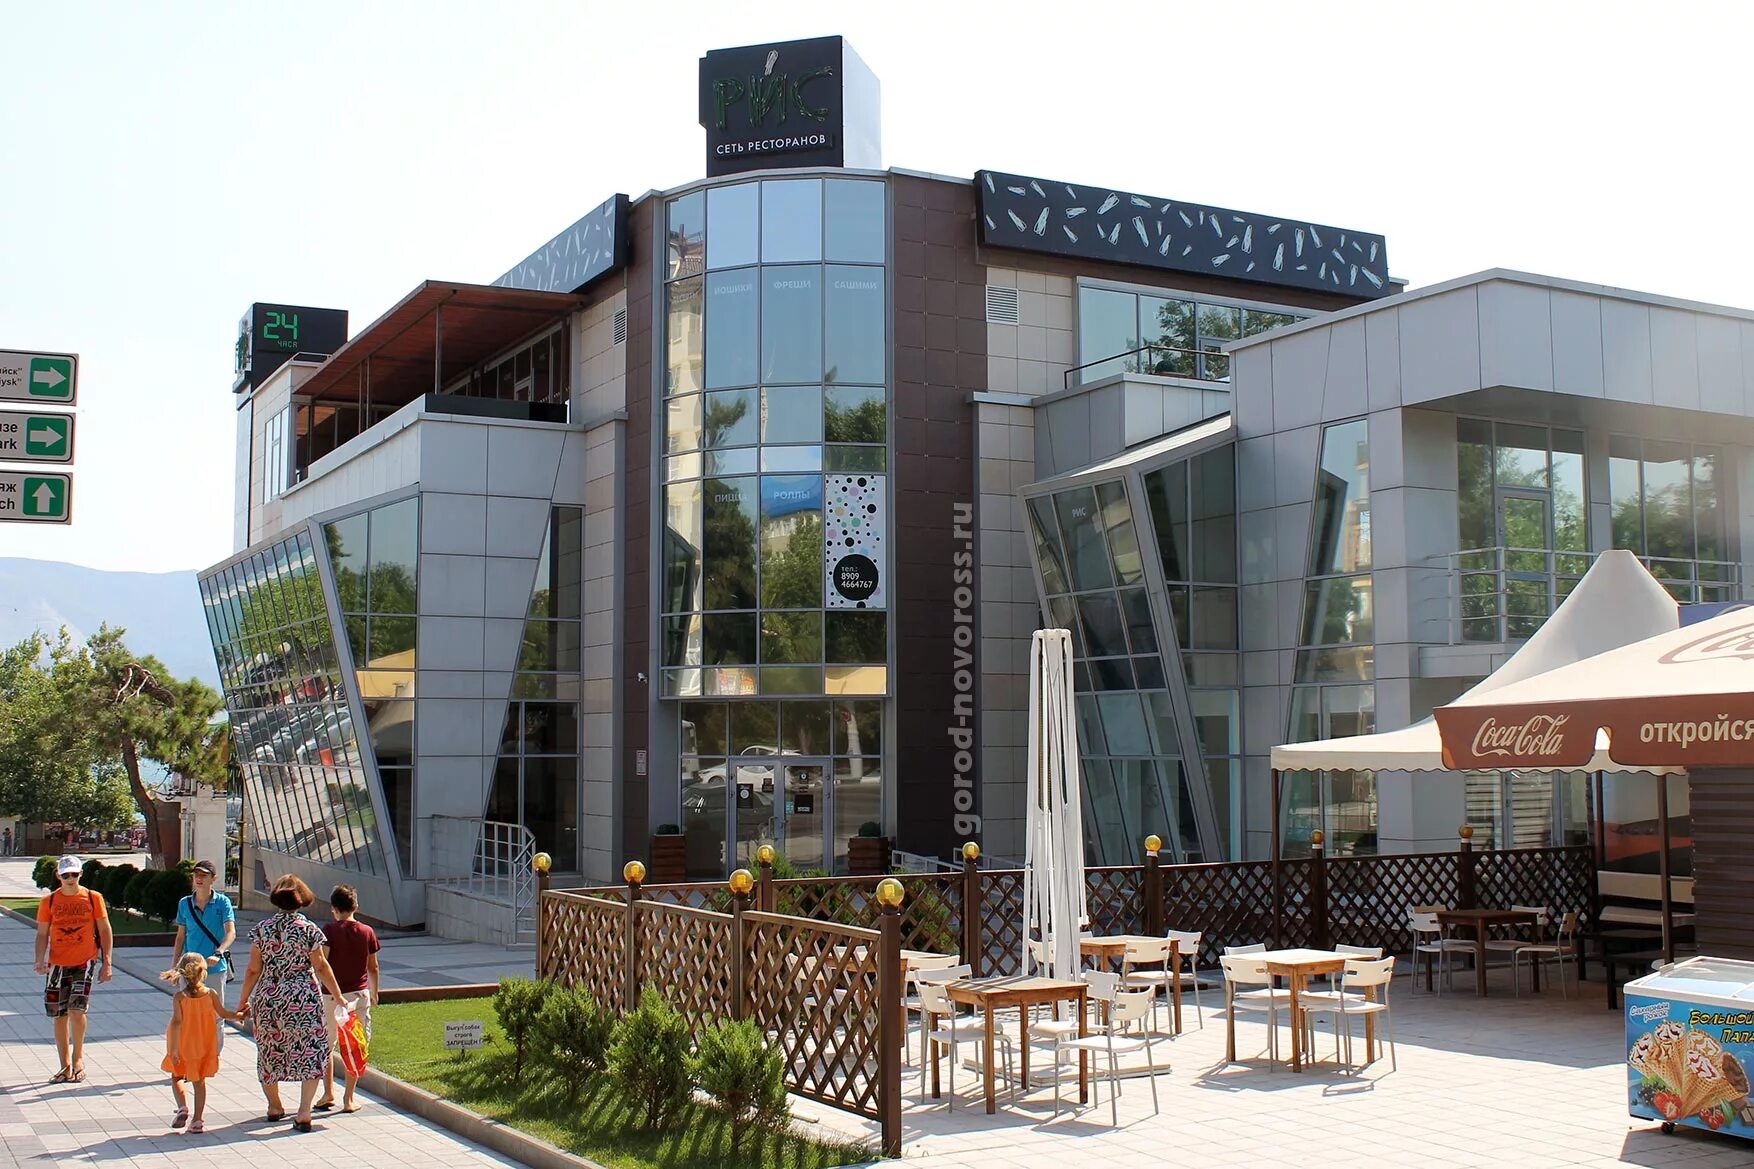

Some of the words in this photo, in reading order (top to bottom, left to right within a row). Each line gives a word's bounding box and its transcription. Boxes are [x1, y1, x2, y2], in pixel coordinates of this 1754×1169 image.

[713, 66, 833, 129] РИС
[716, 143, 744, 155] СЕТЬ
[748, 134, 826, 151] РЕСТОРАНОВ
[773, 279, 811, 290] ФРЕШИ
[834, 280, 878, 290] САШИМИ
[263, 312, 298, 340] 24
[0, 367, 23, 376] йск"
[0, 423, 18, 433] зе
[773, 490, 811, 500] РОЛЛЫ
[841, 572, 860, 580] 8909
[841, 580, 873, 588] 4664767
[1471, 713, 1570, 757] Coca-Cola
